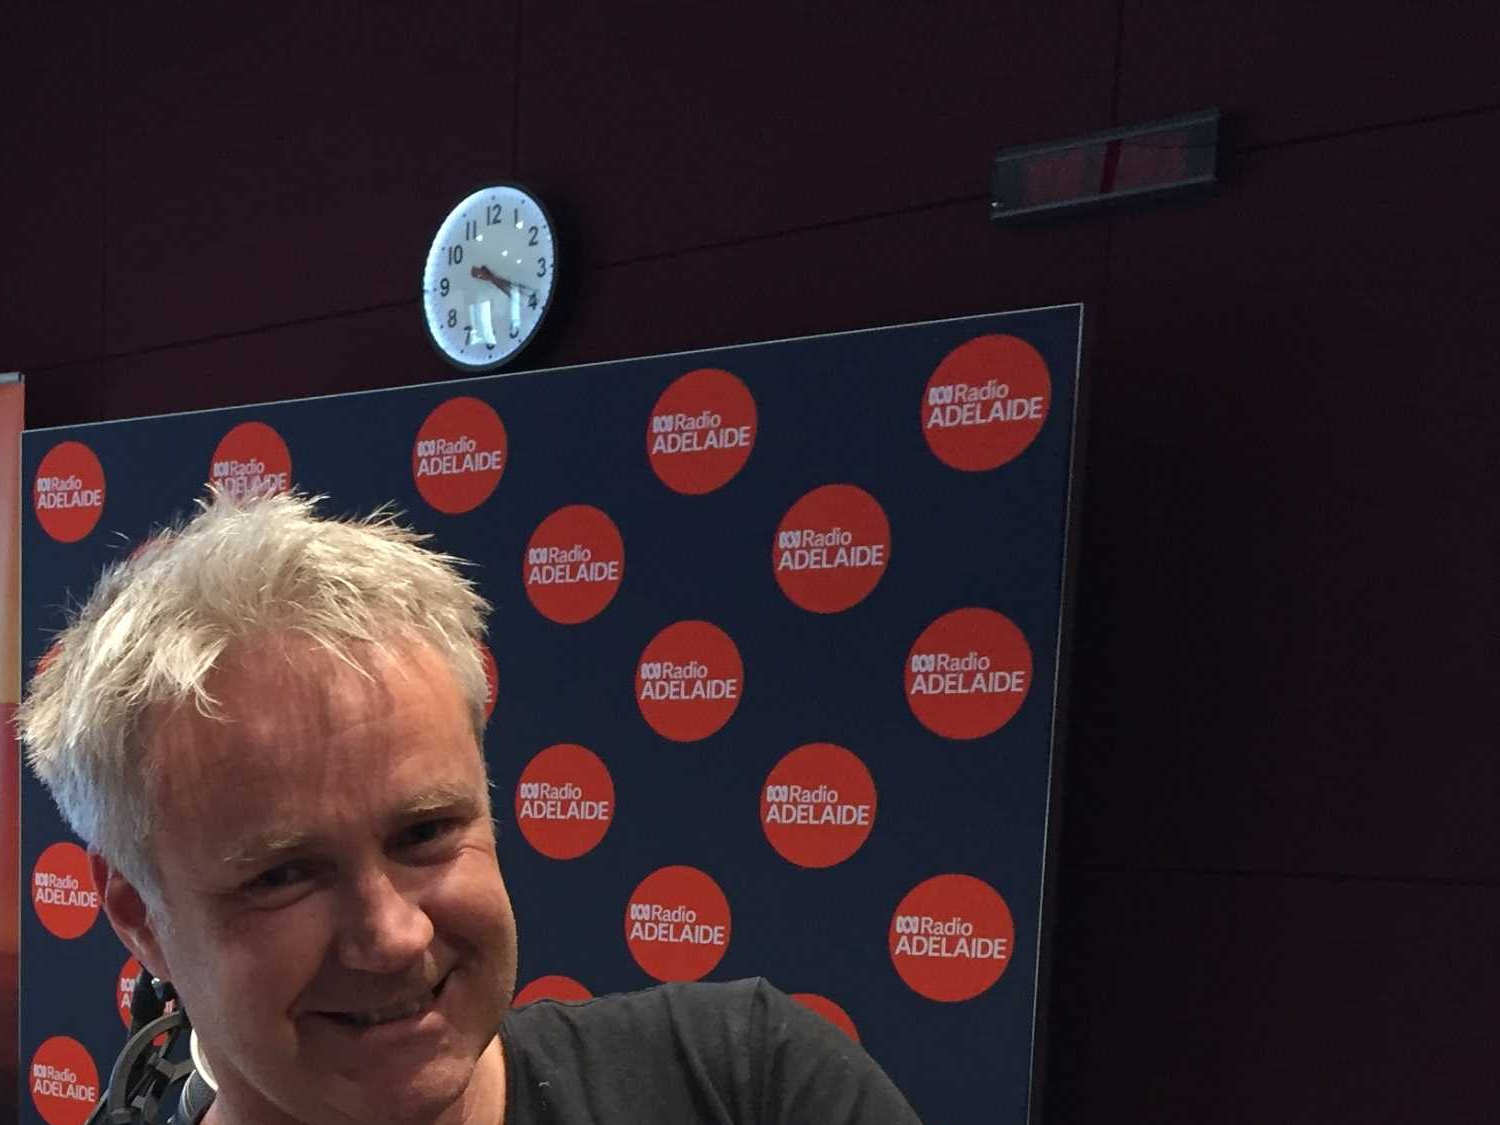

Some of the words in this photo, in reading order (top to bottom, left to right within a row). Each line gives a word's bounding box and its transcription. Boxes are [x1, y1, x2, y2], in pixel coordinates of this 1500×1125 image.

[486, 204, 502, 227] 12
[465, 220, 478, 241] 11
[528, 226, 539, 246] 2
[449, 244, 464, 265] 10
[536, 257, 547, 278] 3
[440, 278, 450, 297] 9
[527, 292, 538, 310] 4
[447, 309, 457, 328] 8
[955, 380, 1009, 402] Radio
[674, 411, 721, 431] Radio
[927, 397, 1044, 428] ADELAIDE
[437, 437, 476, 455] Radio
[652, 426, 751, 454] ADELAIDE
[417, 451, 501, 477] ADELAIDE
[51, 475, 82, 491] Radio
[37, 489, 102, 510] ADELAIDE
[802, 528, 852, 547] Radio
[549, 545, 591, 563] Radio
[778, 544, 884, 571] ADELAIDE
[528, 561, 619, 585] ADELAIDE
[662, 662, 708, 679] Radio
[936, 653, 990, 671] Radio
[641, 678, 737, 700] ADELAIDE
[910, 671, 1024, 694] ADELAIDE
[540, 783, 582, 800] Radio
[789, 785, 838, 803] Radio
[519, 800, 609, 821] ADELAIDE
[766, 804, 870, 826] ADELAIDE
[49, 873, 79, 890] Radio
[36, 888, 98, 908] ADELAIDE
[652, 905, 696, 924] Radio
[629, 922, 725, 946] ADELAIDE
[921, 917, 973, 936] Radio
[895, 935, 1007, 959] ADELAIDE
[48, 1066, 77, 1083] Radio
[34, 1081, 96, 1103] ADELAIDE
